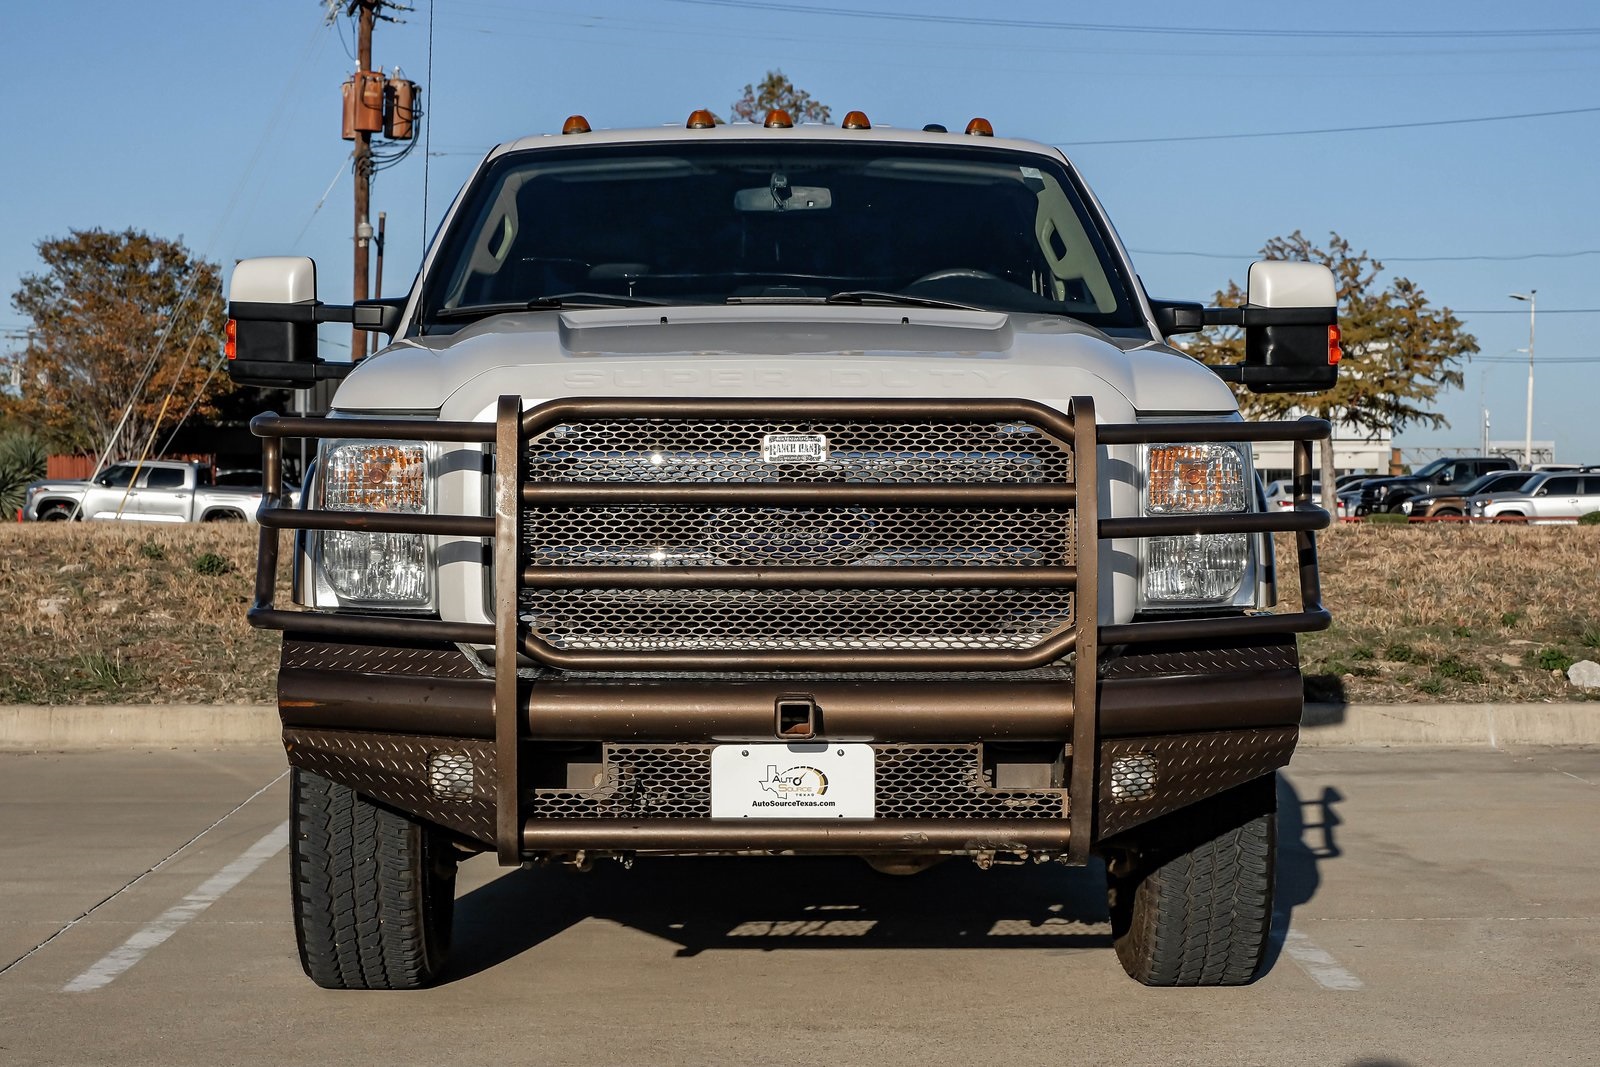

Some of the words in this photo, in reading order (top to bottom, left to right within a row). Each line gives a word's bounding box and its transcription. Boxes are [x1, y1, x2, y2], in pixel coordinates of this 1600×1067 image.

[562, 368, 789, 390] SUPER
[830, 368, 1009, 389] DUTY
[769, 443, 796, 456] RANCH
[798, 443, 821, 456] HAND
